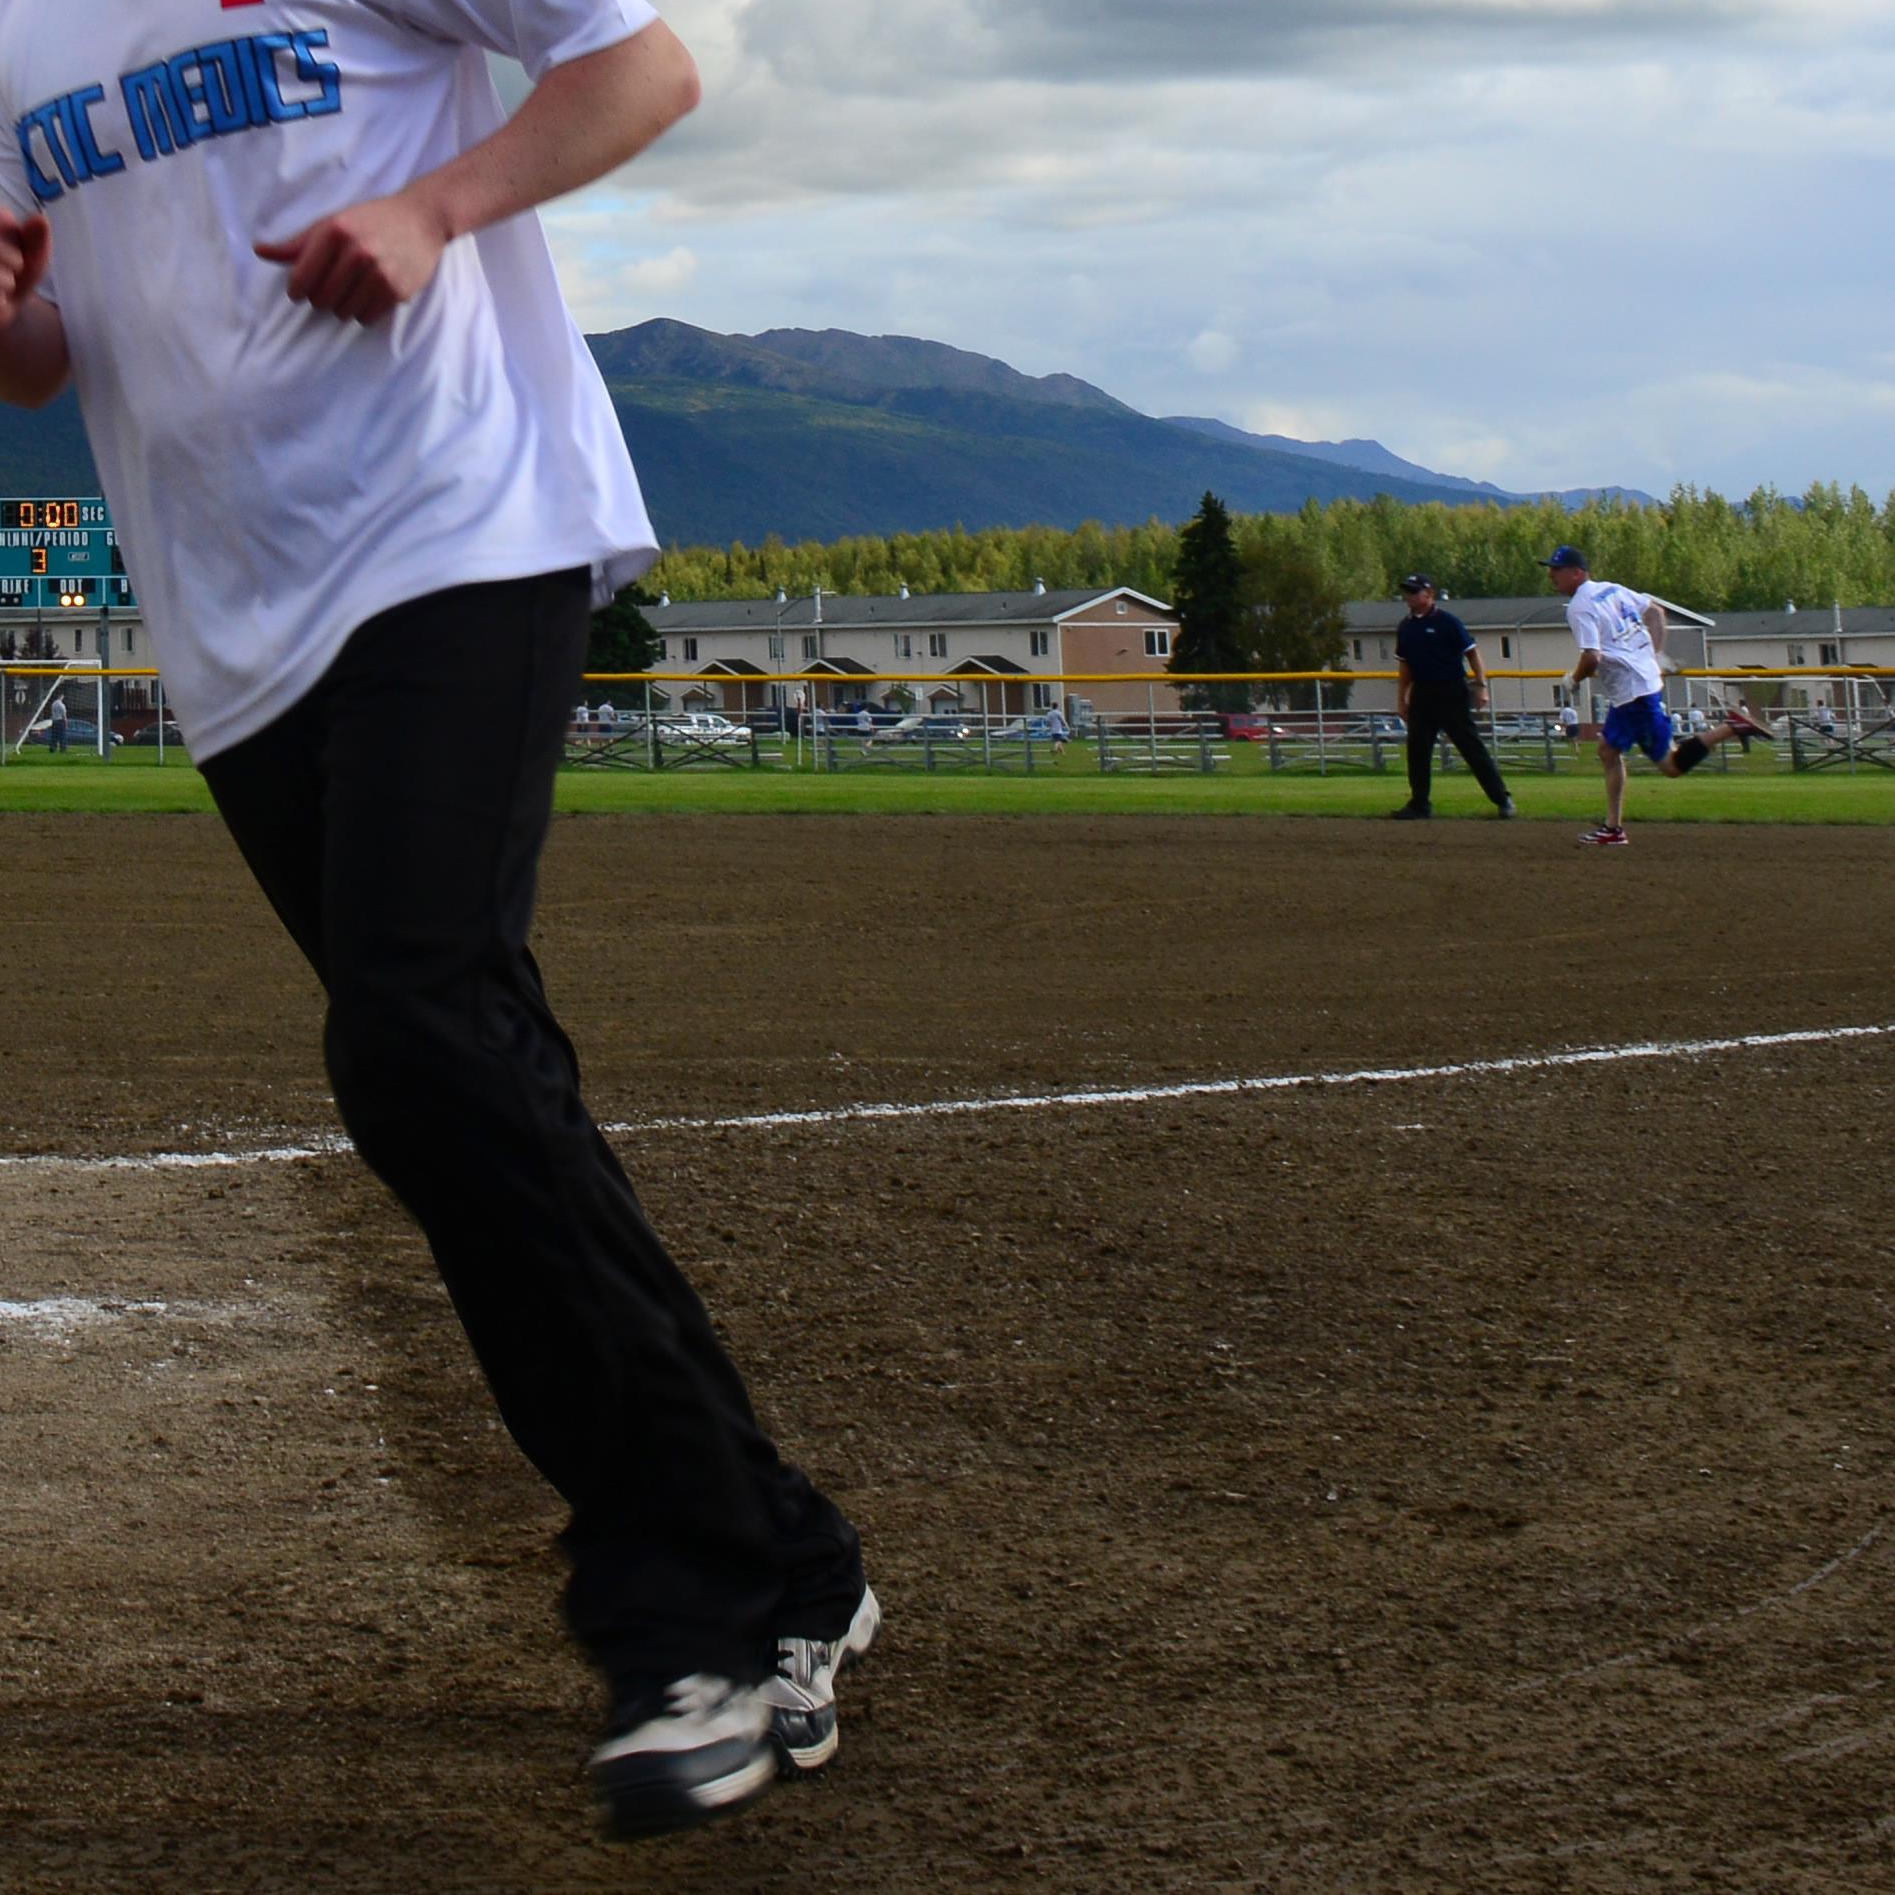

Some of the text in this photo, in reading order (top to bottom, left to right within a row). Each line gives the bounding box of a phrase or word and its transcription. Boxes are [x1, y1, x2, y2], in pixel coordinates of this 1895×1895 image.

[120, 28, 343, 163] MEDICS
[20, 502, 79, 527] 0:00
[81, 506, 105, 521] SEC
[32, 549, 47, 573] 3
[60, 579, 83, 594] OUT
